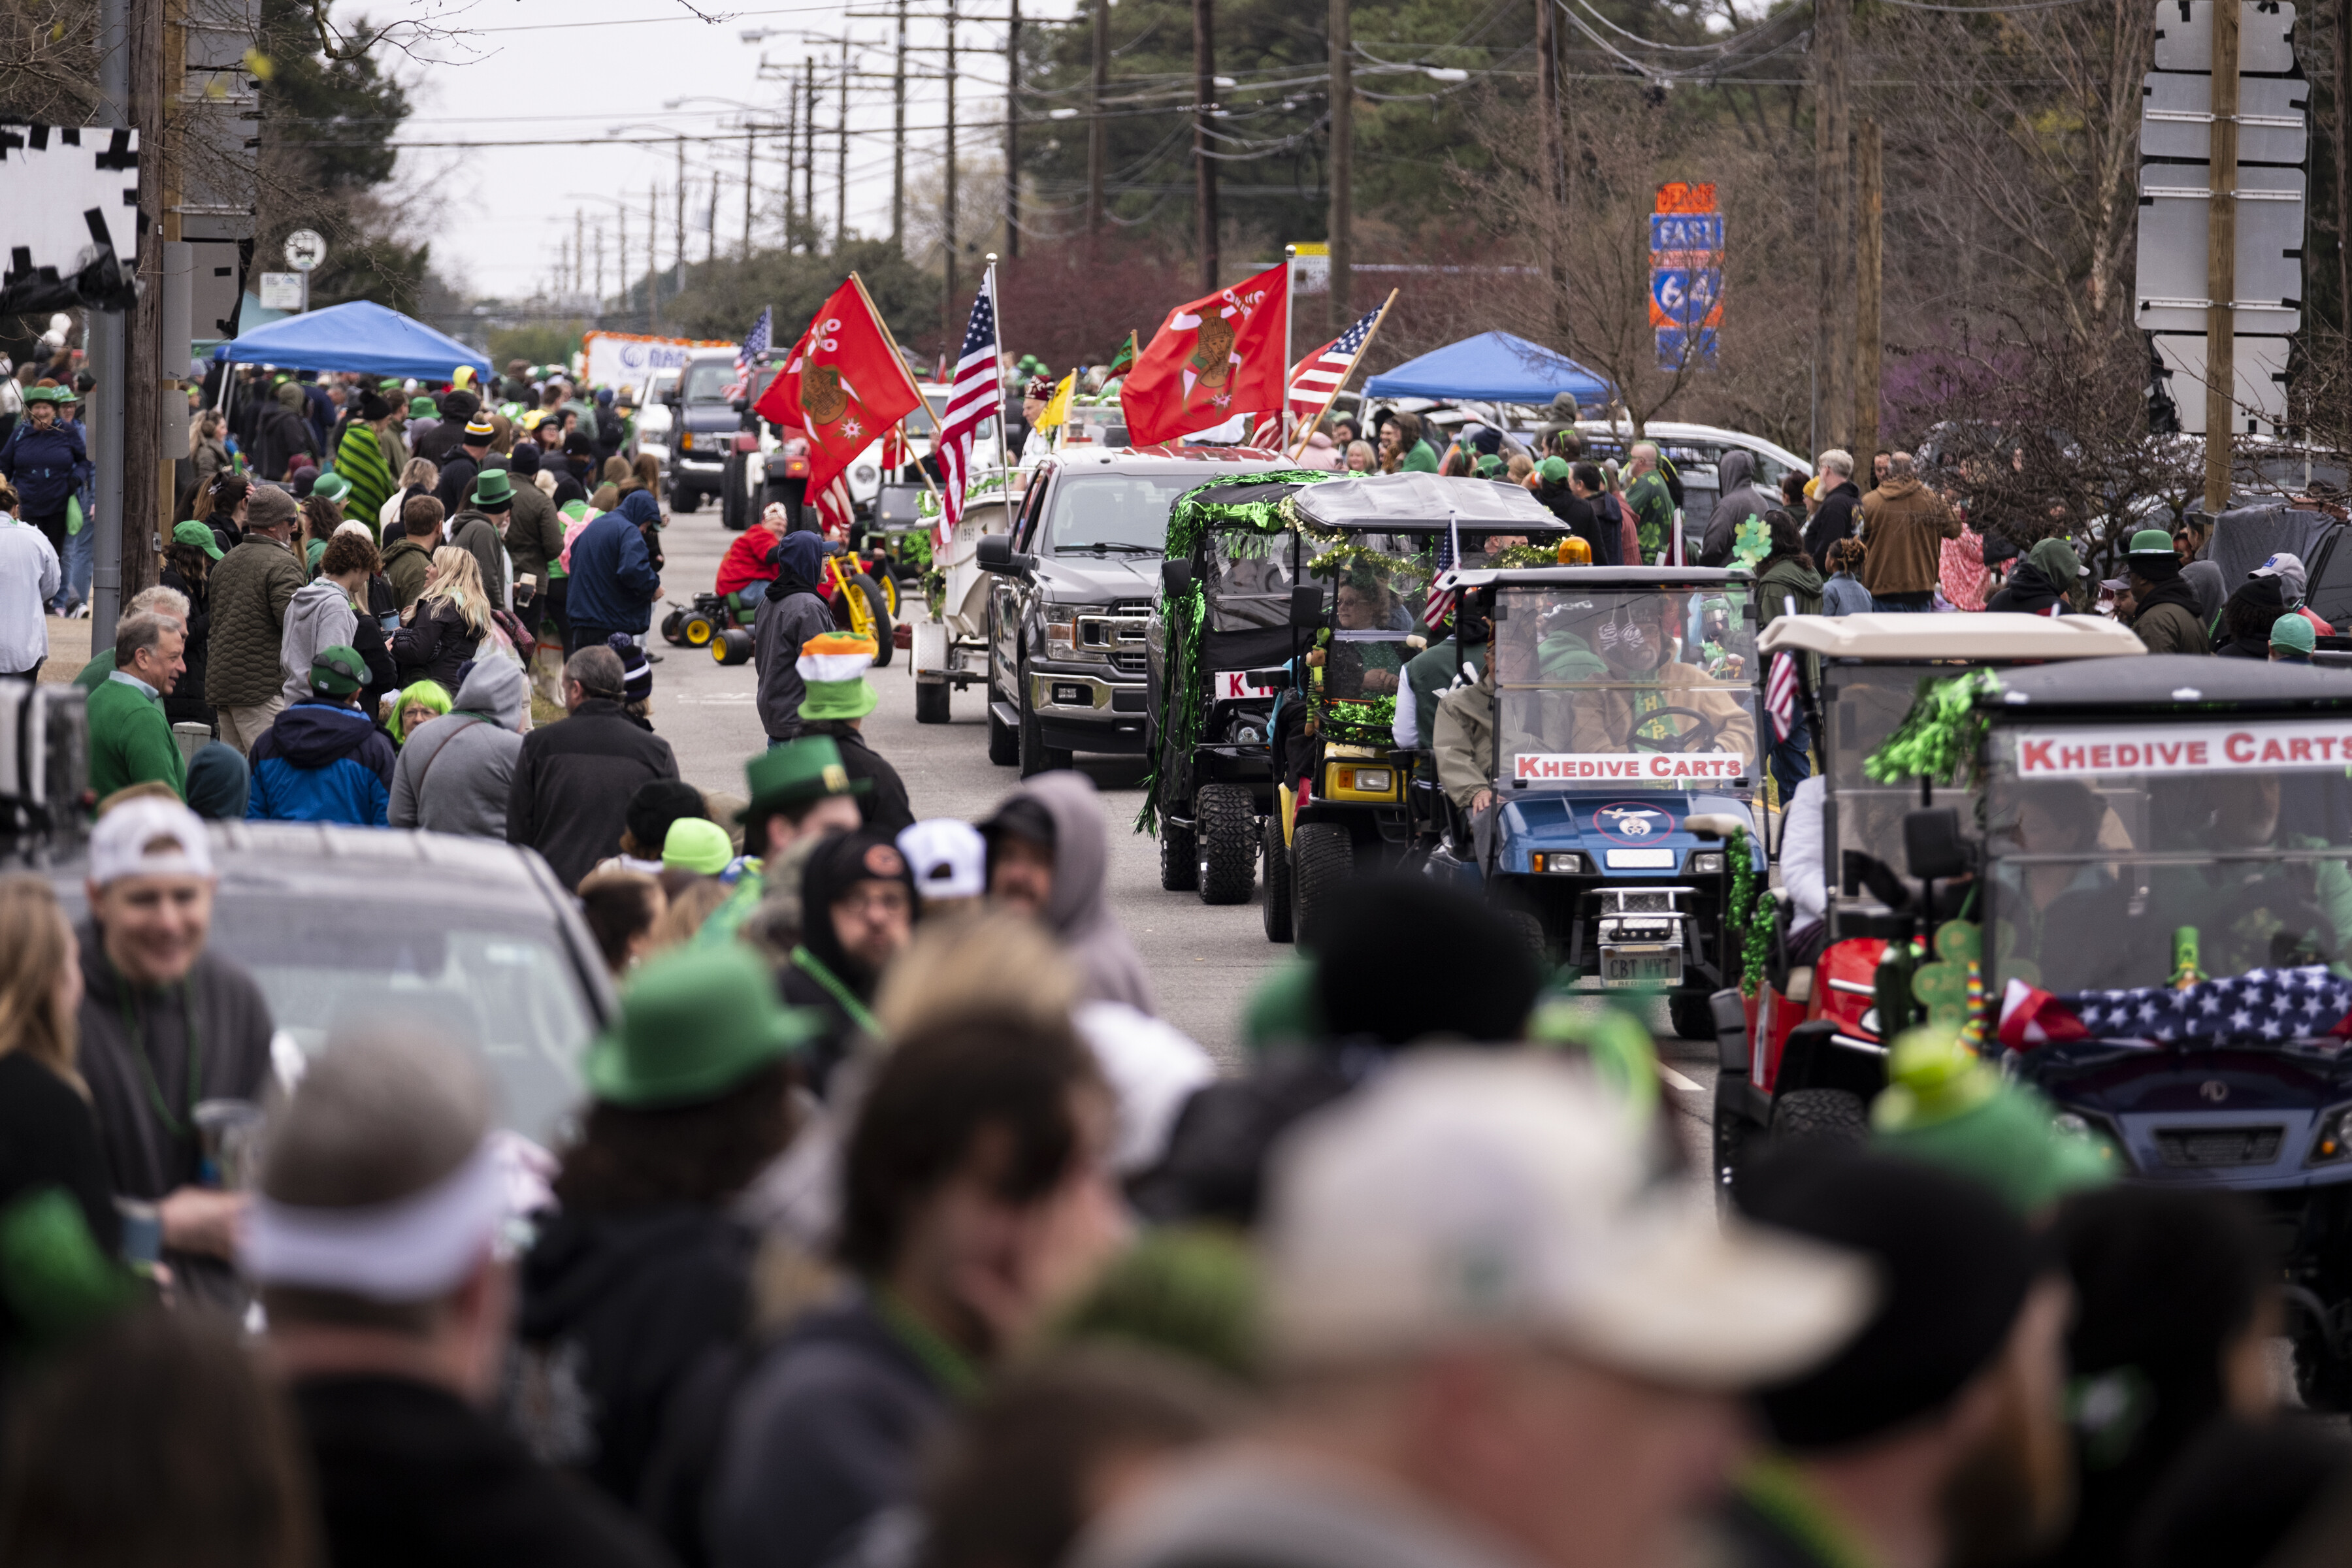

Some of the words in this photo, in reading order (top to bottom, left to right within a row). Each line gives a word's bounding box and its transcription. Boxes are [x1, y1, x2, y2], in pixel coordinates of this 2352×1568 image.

[1661, 275, 1714, 310] 64
[1518, 757, 1640, 777] KHEDIVE
[1650, 756, 1741, 777] CARTS
[1610, 959, 1637, 978] CBT
